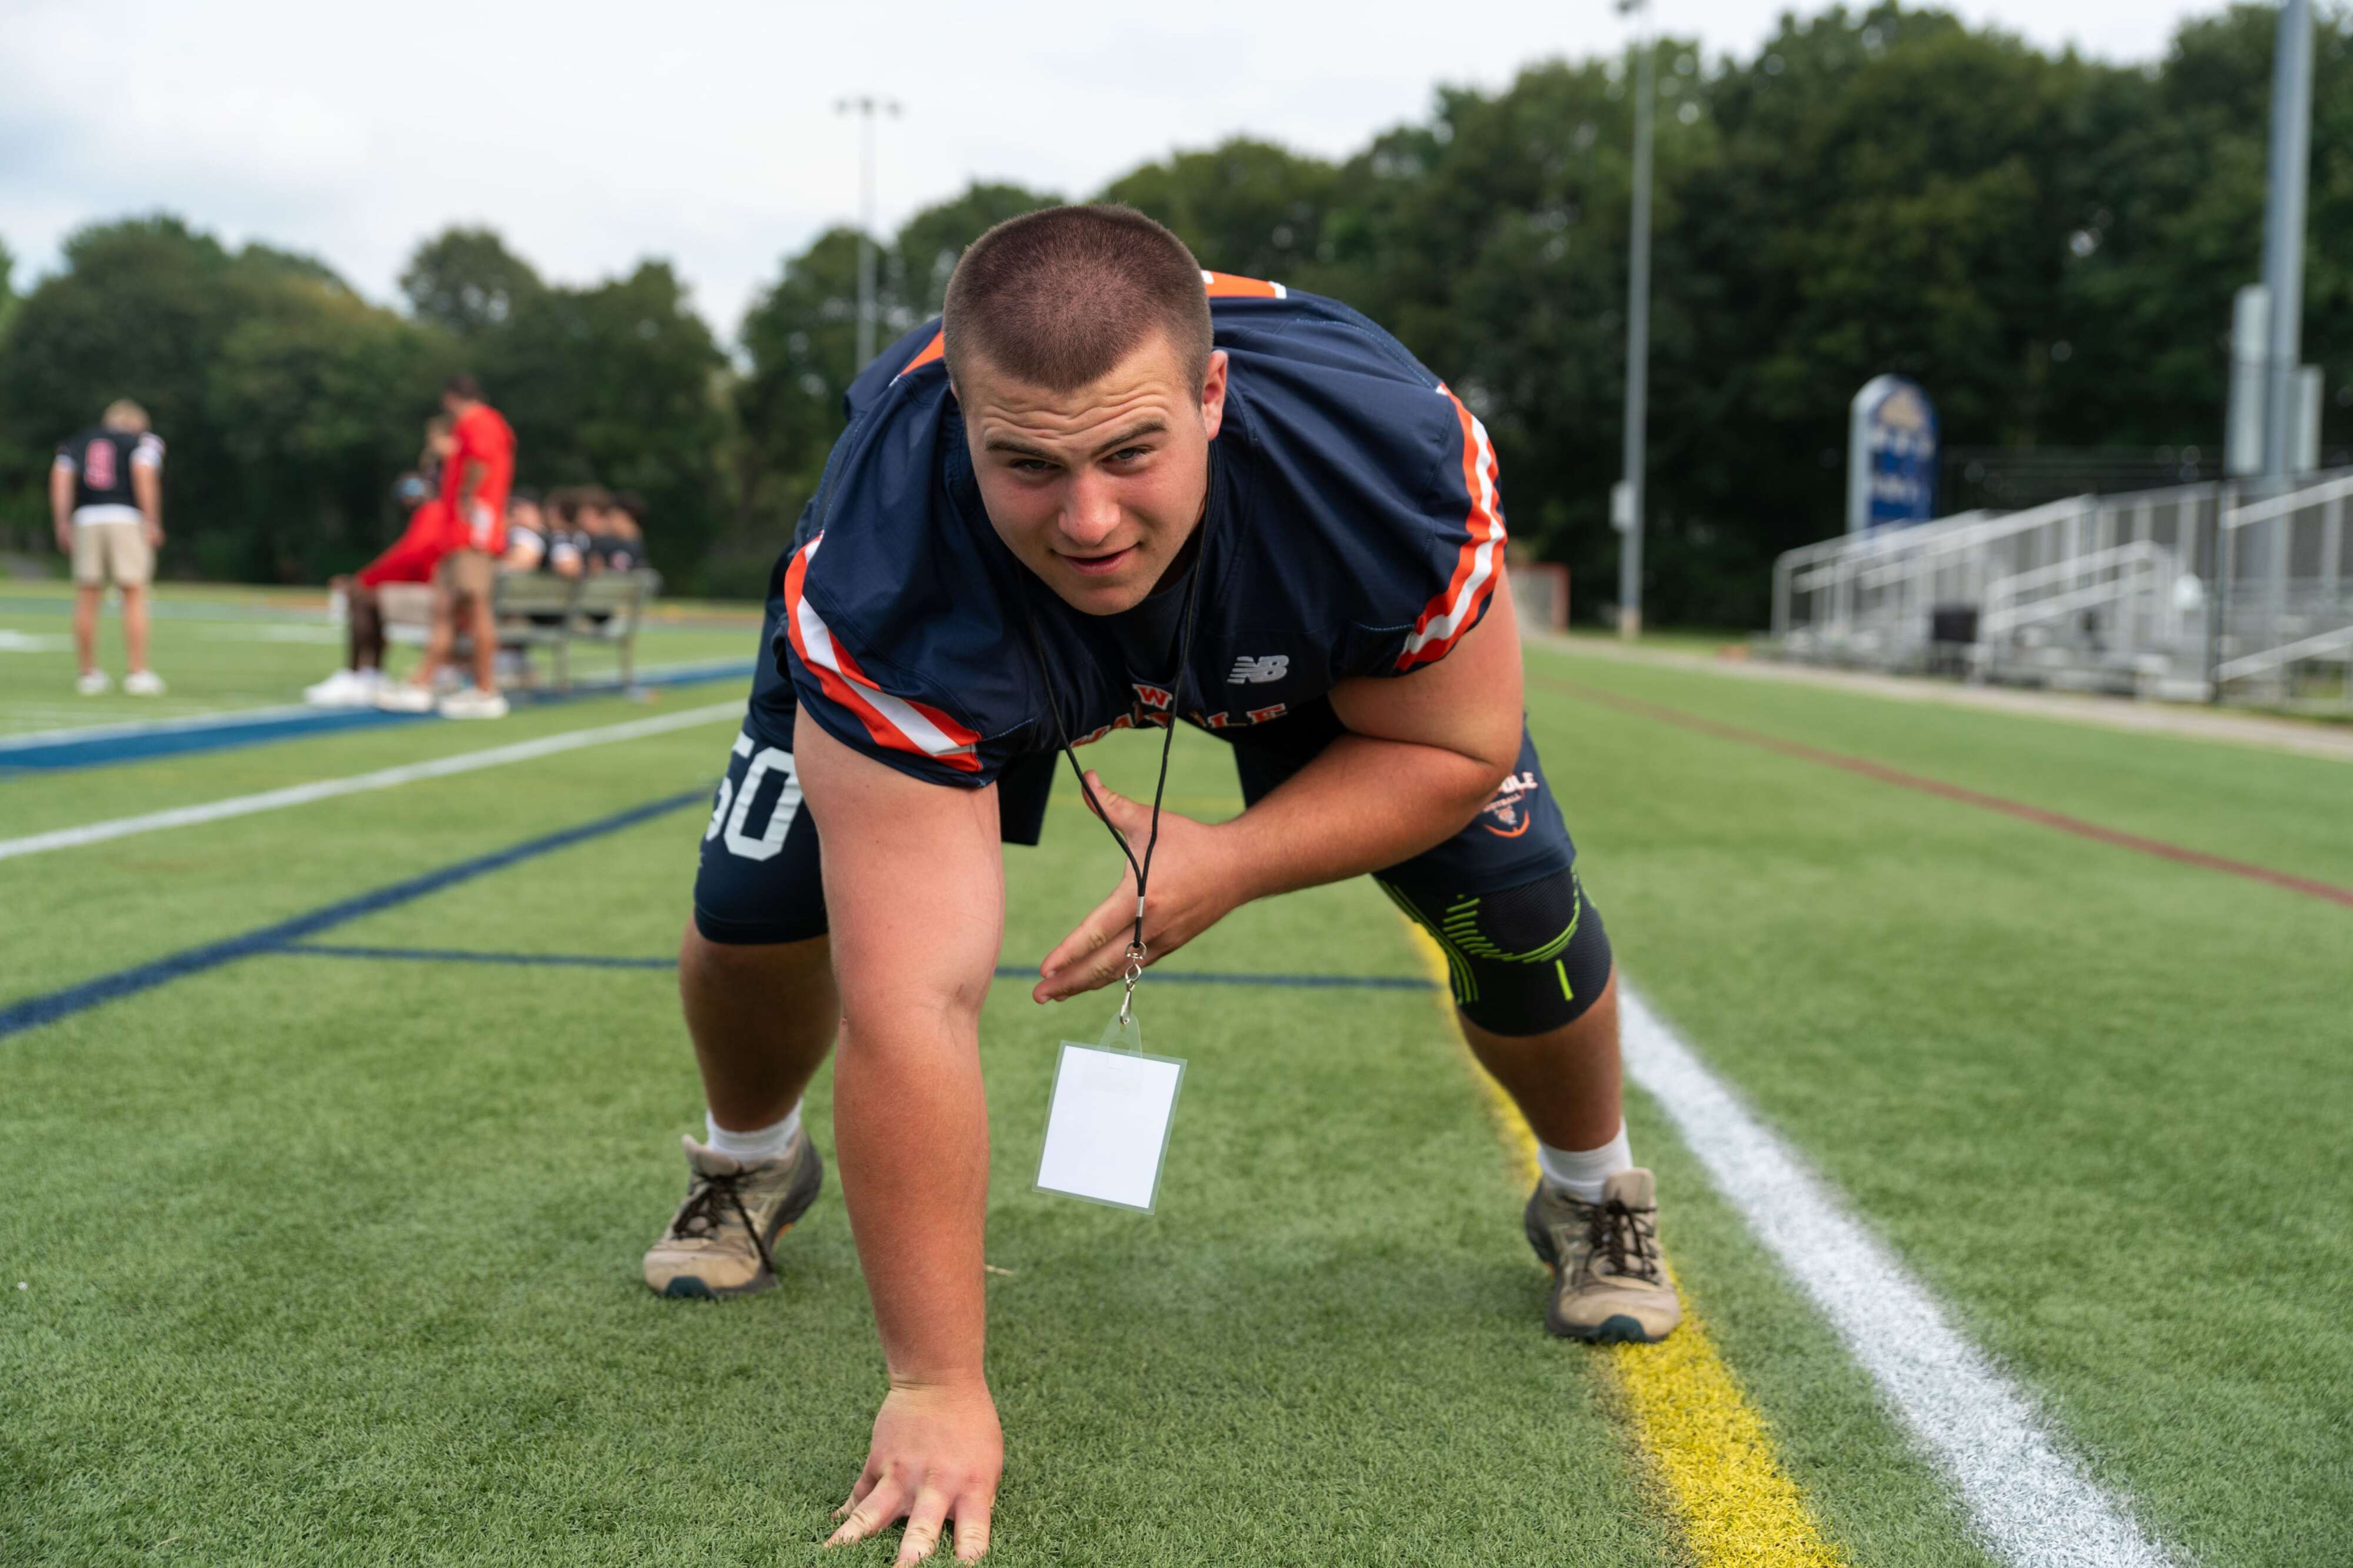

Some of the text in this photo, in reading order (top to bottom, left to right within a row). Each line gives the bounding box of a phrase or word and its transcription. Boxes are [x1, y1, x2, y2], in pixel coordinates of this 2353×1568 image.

[1227, 655, 1289, 685] NB
[1132, 683, 1173, 710] W
[1498, 772, 1539, 793] OLE
